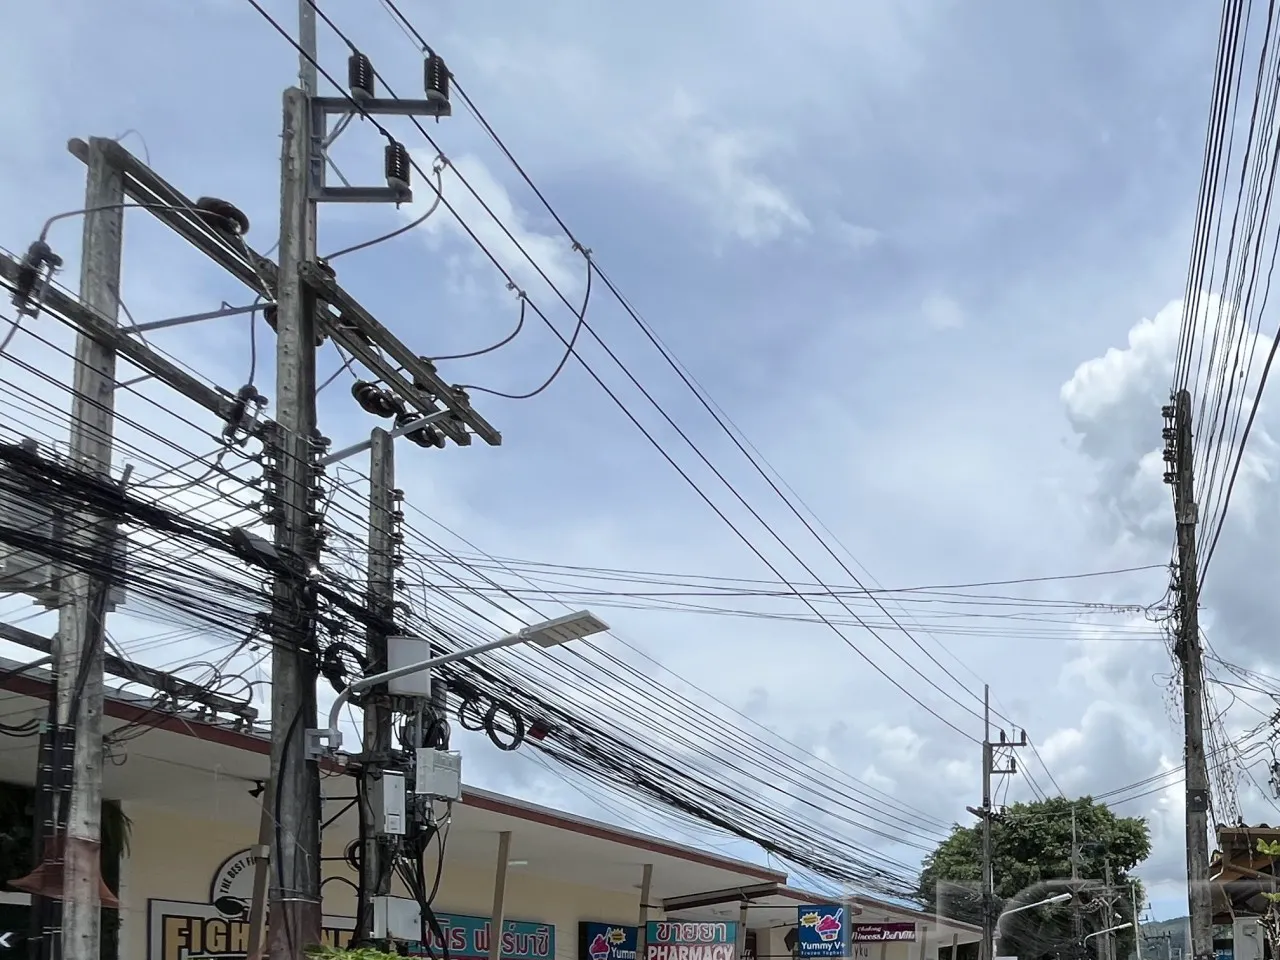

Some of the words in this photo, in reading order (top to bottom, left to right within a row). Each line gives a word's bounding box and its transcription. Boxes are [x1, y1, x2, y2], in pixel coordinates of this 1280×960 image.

[226, 860, 248, 880] BEST
[656, 922, 727, 942] ขายยา
[801, 941, 833, 951] Yummy
